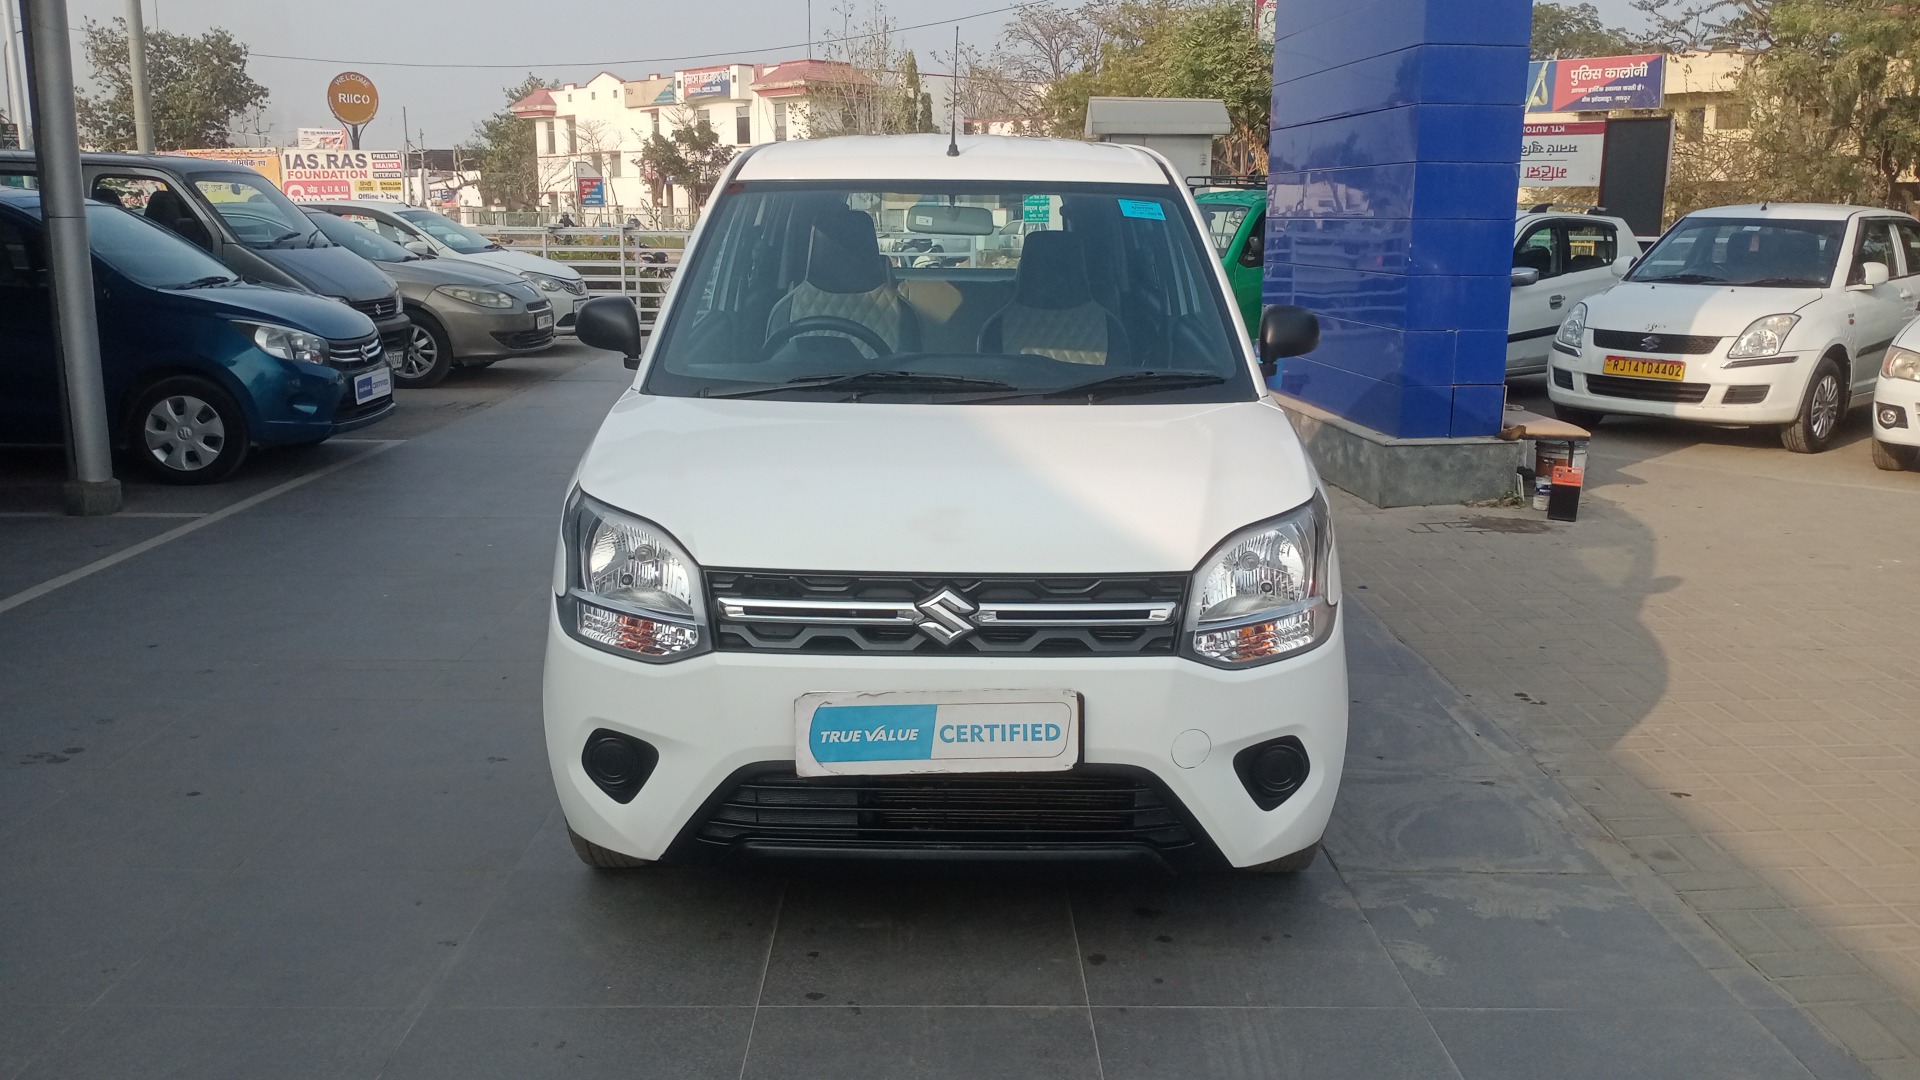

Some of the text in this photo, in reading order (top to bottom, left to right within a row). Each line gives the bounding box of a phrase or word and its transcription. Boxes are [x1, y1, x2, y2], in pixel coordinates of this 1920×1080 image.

[335, 74, 370, 88] WELCOME
[1570, 62, 1649, 86] पुलिस कालोनी
[338, 92, 370, 104] RIICO
[1523, 125, 1565, 133] KTL AUTO
[1546, 144, 1578, 156] मनाएं
[285, 154, 319, 169] IAS
[326, 153, 368, 169] RAS
[287, 170, 368, 179] FOUNDATION
[1524, 165, 1567, 181] महिंद्रा
[1612, 360, 1682, 376] RJ14TD4402
[820, 723, 1061, 743] TRUE VALUE CERTIFIED
